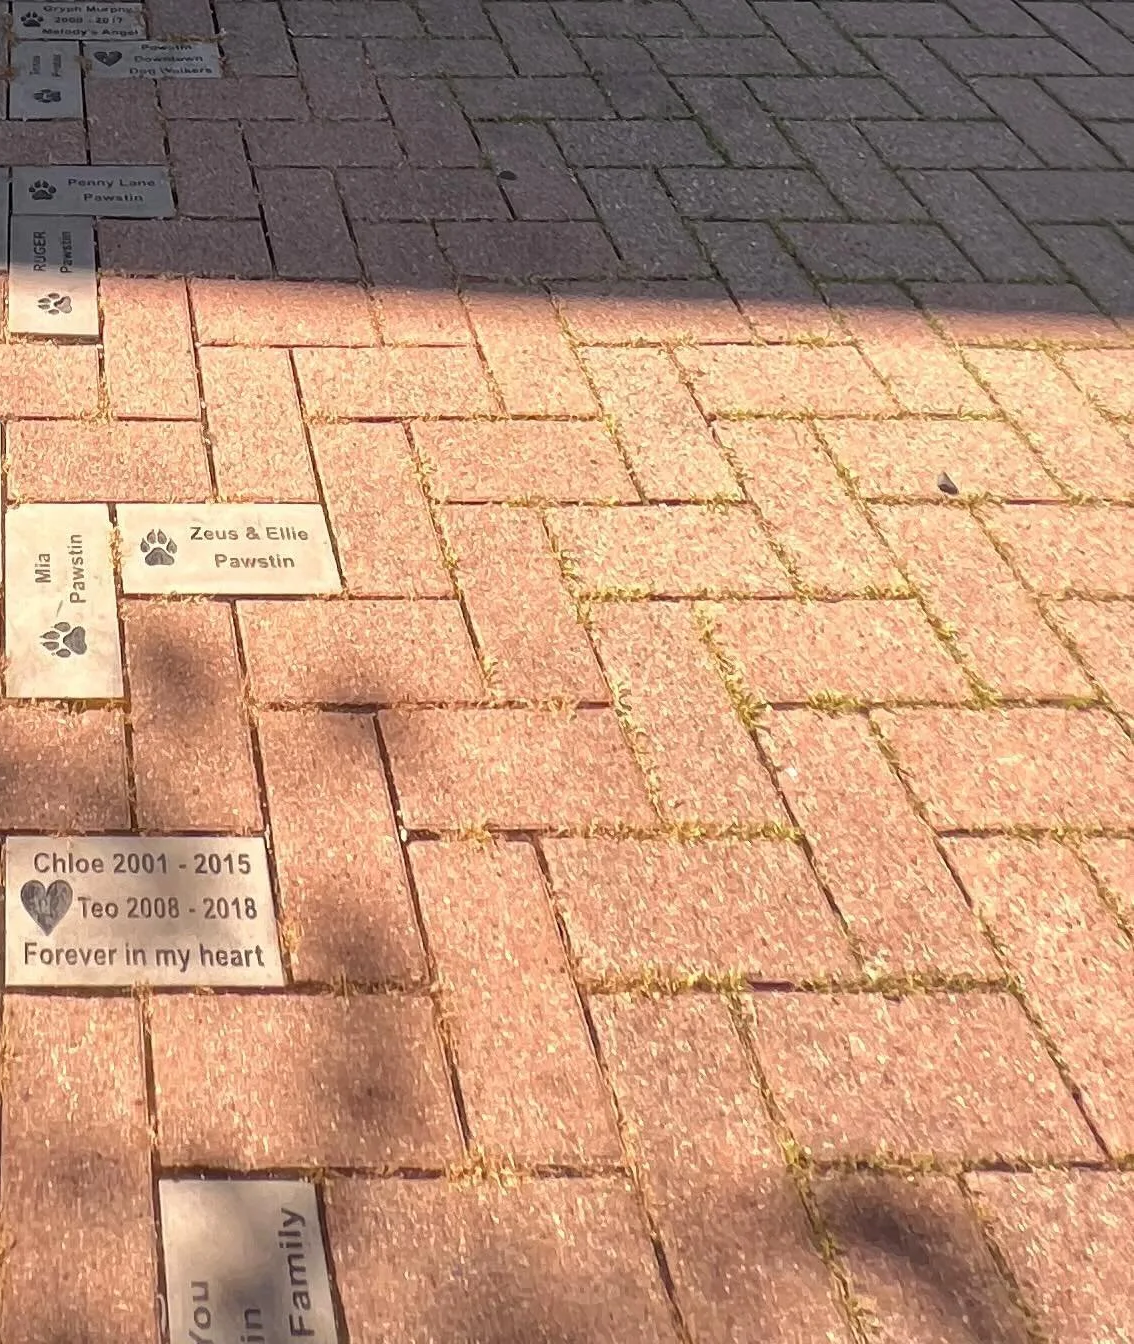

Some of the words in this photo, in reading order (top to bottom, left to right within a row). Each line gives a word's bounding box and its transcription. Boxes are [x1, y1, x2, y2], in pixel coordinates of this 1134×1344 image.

[102, 28, 139, 37] Angel
[129, 67, 156, 76] Dog
[68, 178, 114, 188] Penny
[119, 178, 156, 187] Lane
[83, 193, 144, 202] Pawstin
[33, 230, 47, 273] RUGER
[59, 231, 73, 274] Pawstin
[189, 526, 239, 541] Zeus
[245, 526, 260, 541] &
[266, 526, 309, 541] Ellie
[35, 553, 52, 584] Mia
[68, 533, 87, 604] Pawstin
[214, 553, 296, 569] Pawstin
[34, 852, 105, 874] Chloe
[113, 853, 168, 875] 2001
[193, 853, 252, 875] 2015
[77, 896, 120, 919] Teo
[126, 896, 180, 919] 2008
[202, 897, 258, 920] 2018
[24, 942, 118, 966] Forever
[125, 942, 147, 966] in
[155, 949, 191, 973] my
[200, 943, 265, 968] heart
[278, 1208, 315, 1338] Family
